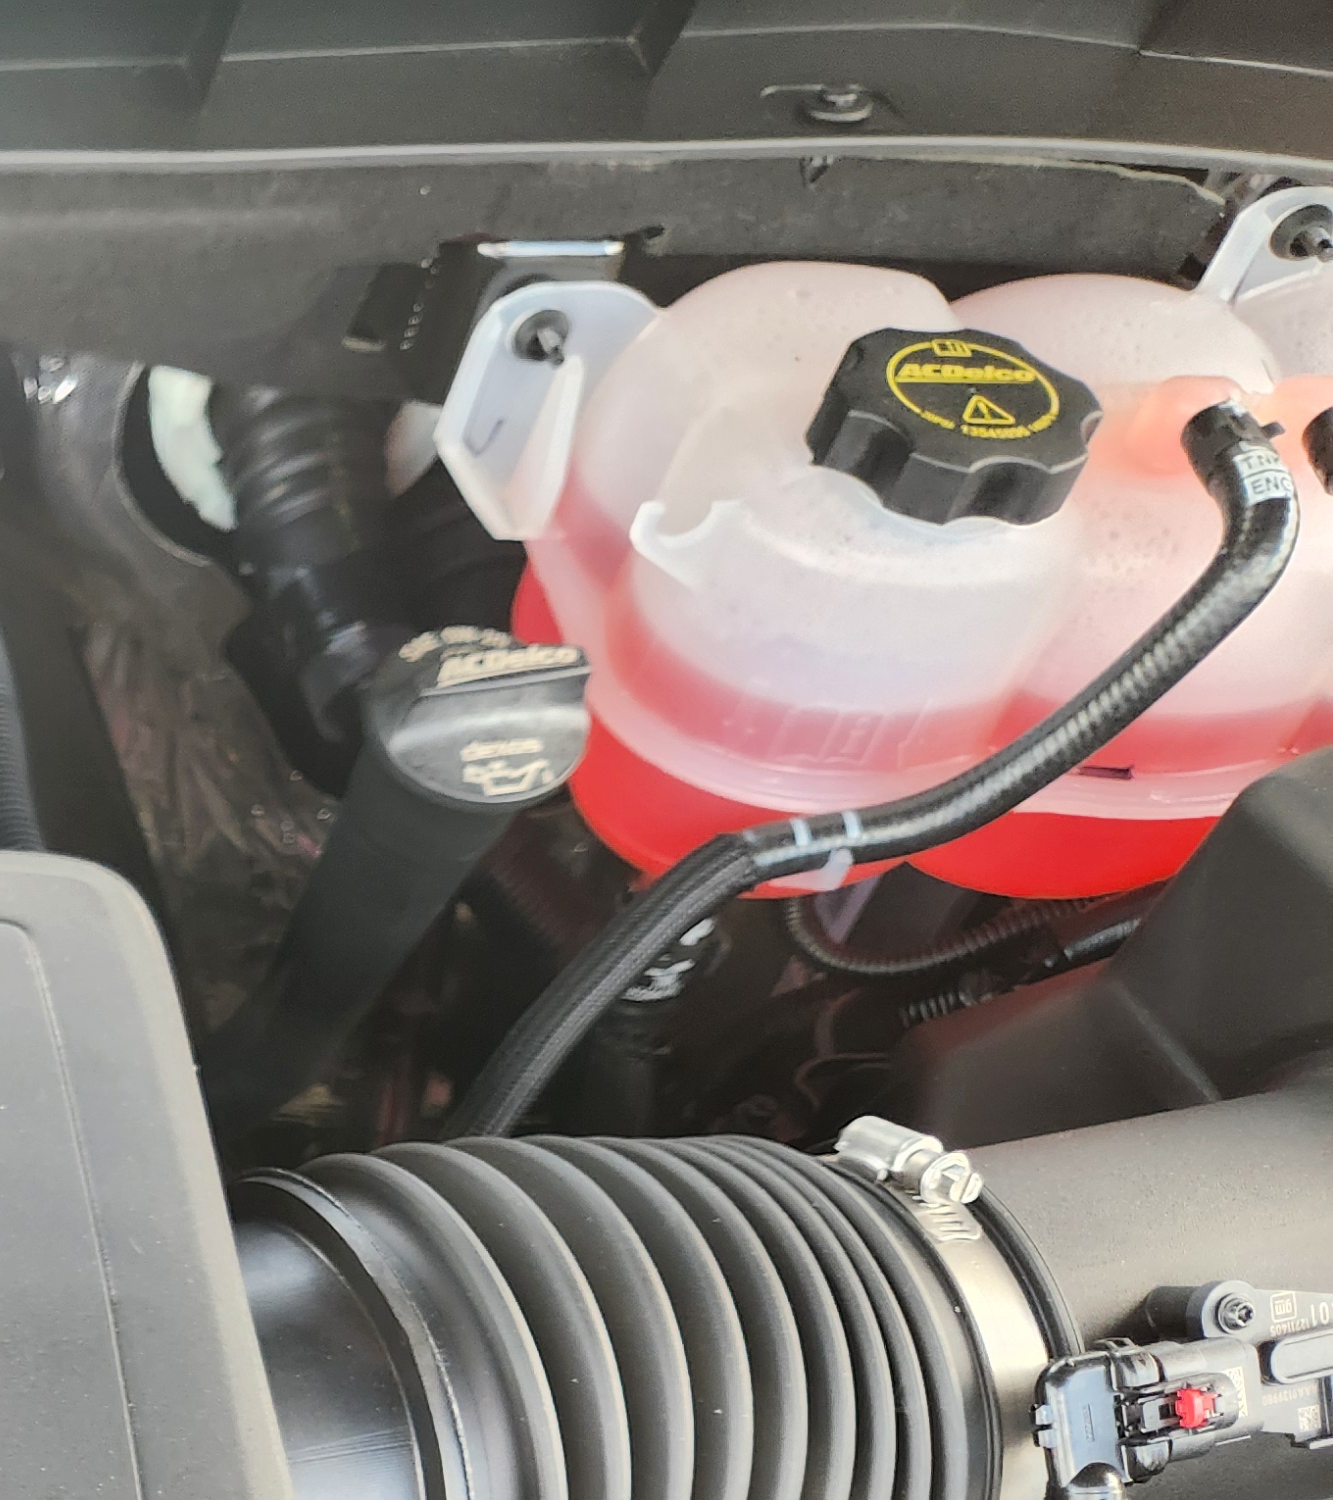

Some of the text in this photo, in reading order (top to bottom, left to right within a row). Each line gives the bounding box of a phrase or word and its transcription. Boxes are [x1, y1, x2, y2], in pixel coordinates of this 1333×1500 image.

[895, 362, 1035, 382] ACDelco
[437, 645, 580, 684] ACDelco
[1274, 1298, 1293, 1316] gm
[1269, 1319, 1309, 1337] 12711405
